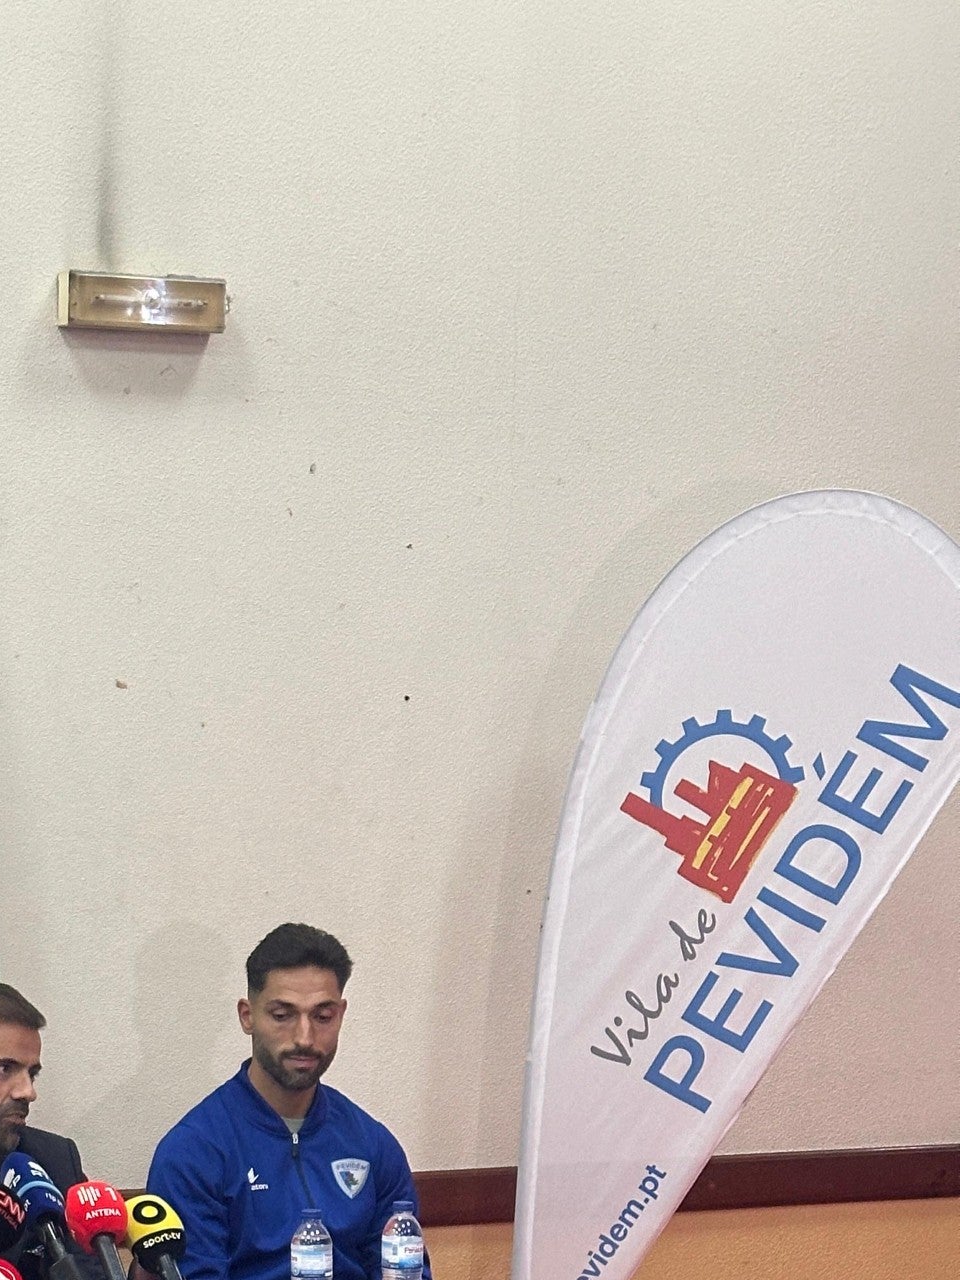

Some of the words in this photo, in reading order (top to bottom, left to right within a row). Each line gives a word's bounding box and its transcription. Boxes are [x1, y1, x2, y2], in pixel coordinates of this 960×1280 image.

[643, 663, 960, 1114] PEVIDÉM
[590, 972, 680, 1066] Vila
[668, 908, 716, 962] de
[85, 1207, 121, 1220] ANTENA
